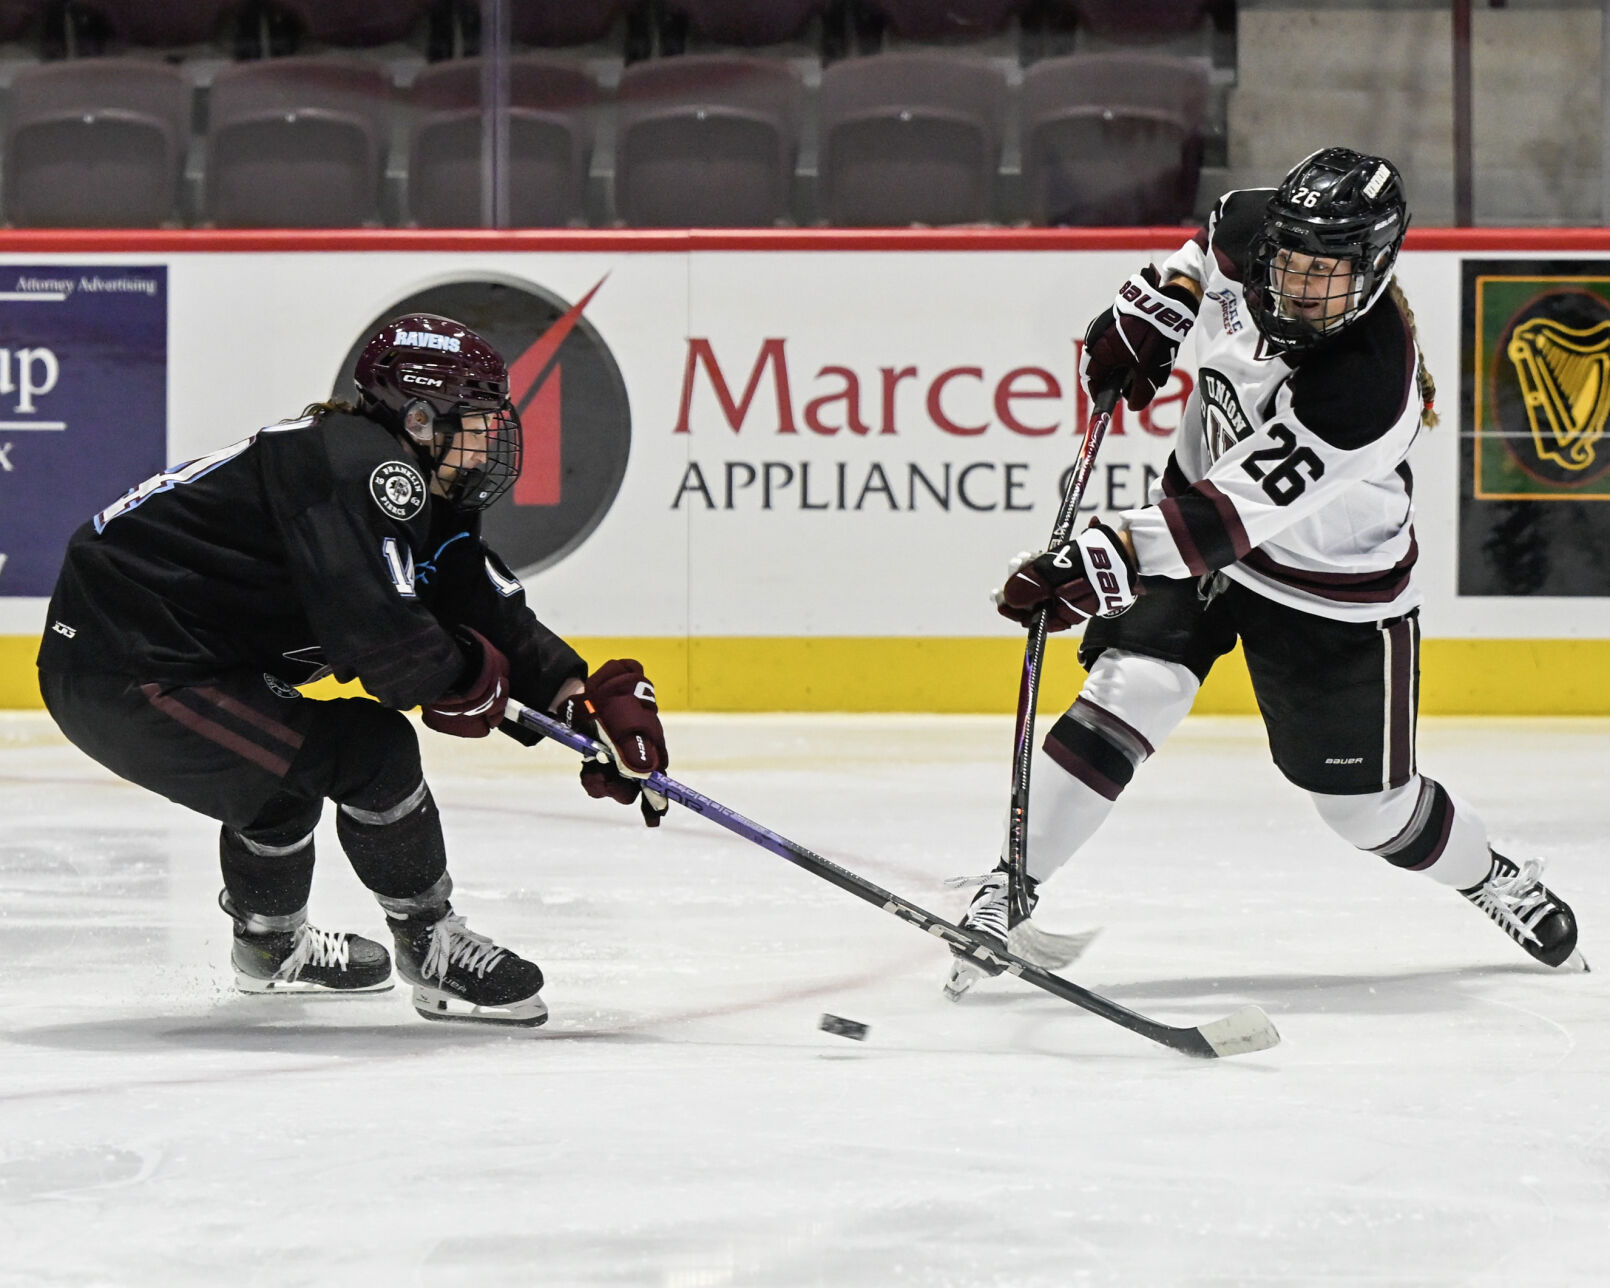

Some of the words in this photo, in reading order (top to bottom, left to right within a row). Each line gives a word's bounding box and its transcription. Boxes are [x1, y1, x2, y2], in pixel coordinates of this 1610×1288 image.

[1291, 187, 1321, 208] 26
[16, 276, 74, 293] Attorney
[78, 276, 157, 296] Advertising
[394, 331, 461, 353] RAVENS
[402, 374, 444, 388] CCM
[1205, 375, 1248, 433] UNION
[1240, 422, 1325, 507] 26
[382, 465, 422, 492] FRANKLIN
[670, 461, 1035, 513] APPLIANCE
[635, 735, 647, 761] CCM
[1325, 757, 1364, 765] BAUER
